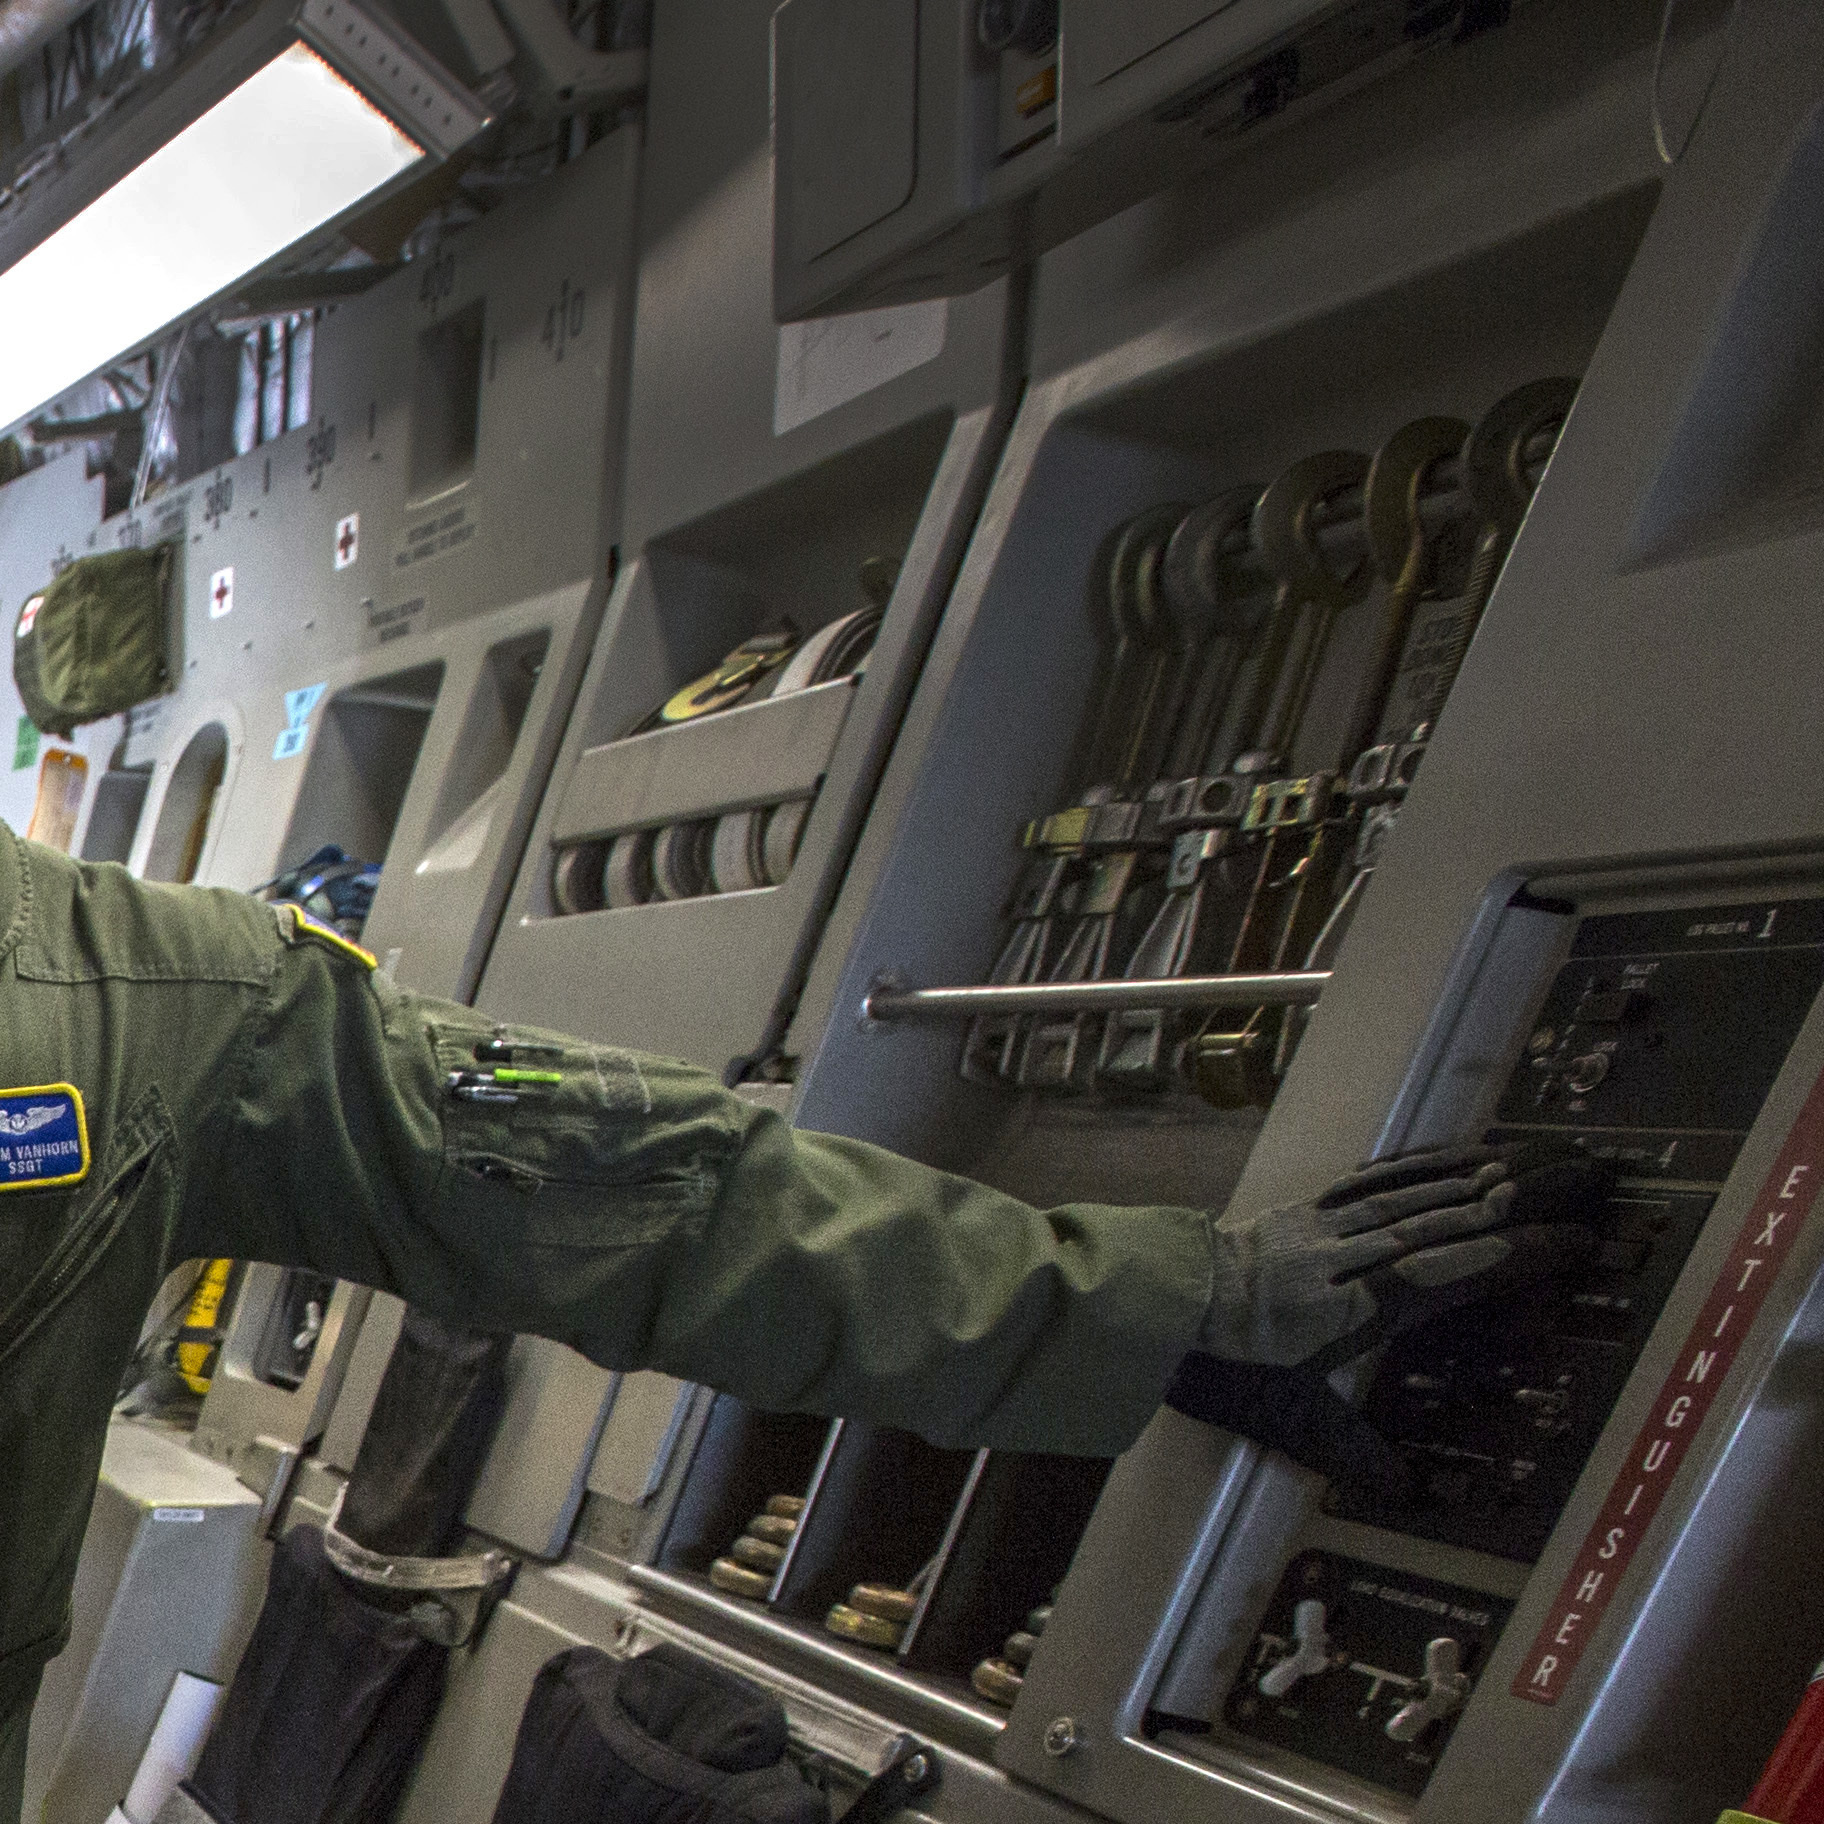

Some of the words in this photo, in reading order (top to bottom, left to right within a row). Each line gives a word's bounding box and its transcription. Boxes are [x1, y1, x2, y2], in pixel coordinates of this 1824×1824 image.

[17, 1139, 80, 1161] VANHORN
[7, 1159, 43, 1175] SSGT
[1530, 1164, 1809, 1688] EXTINGUISHER
